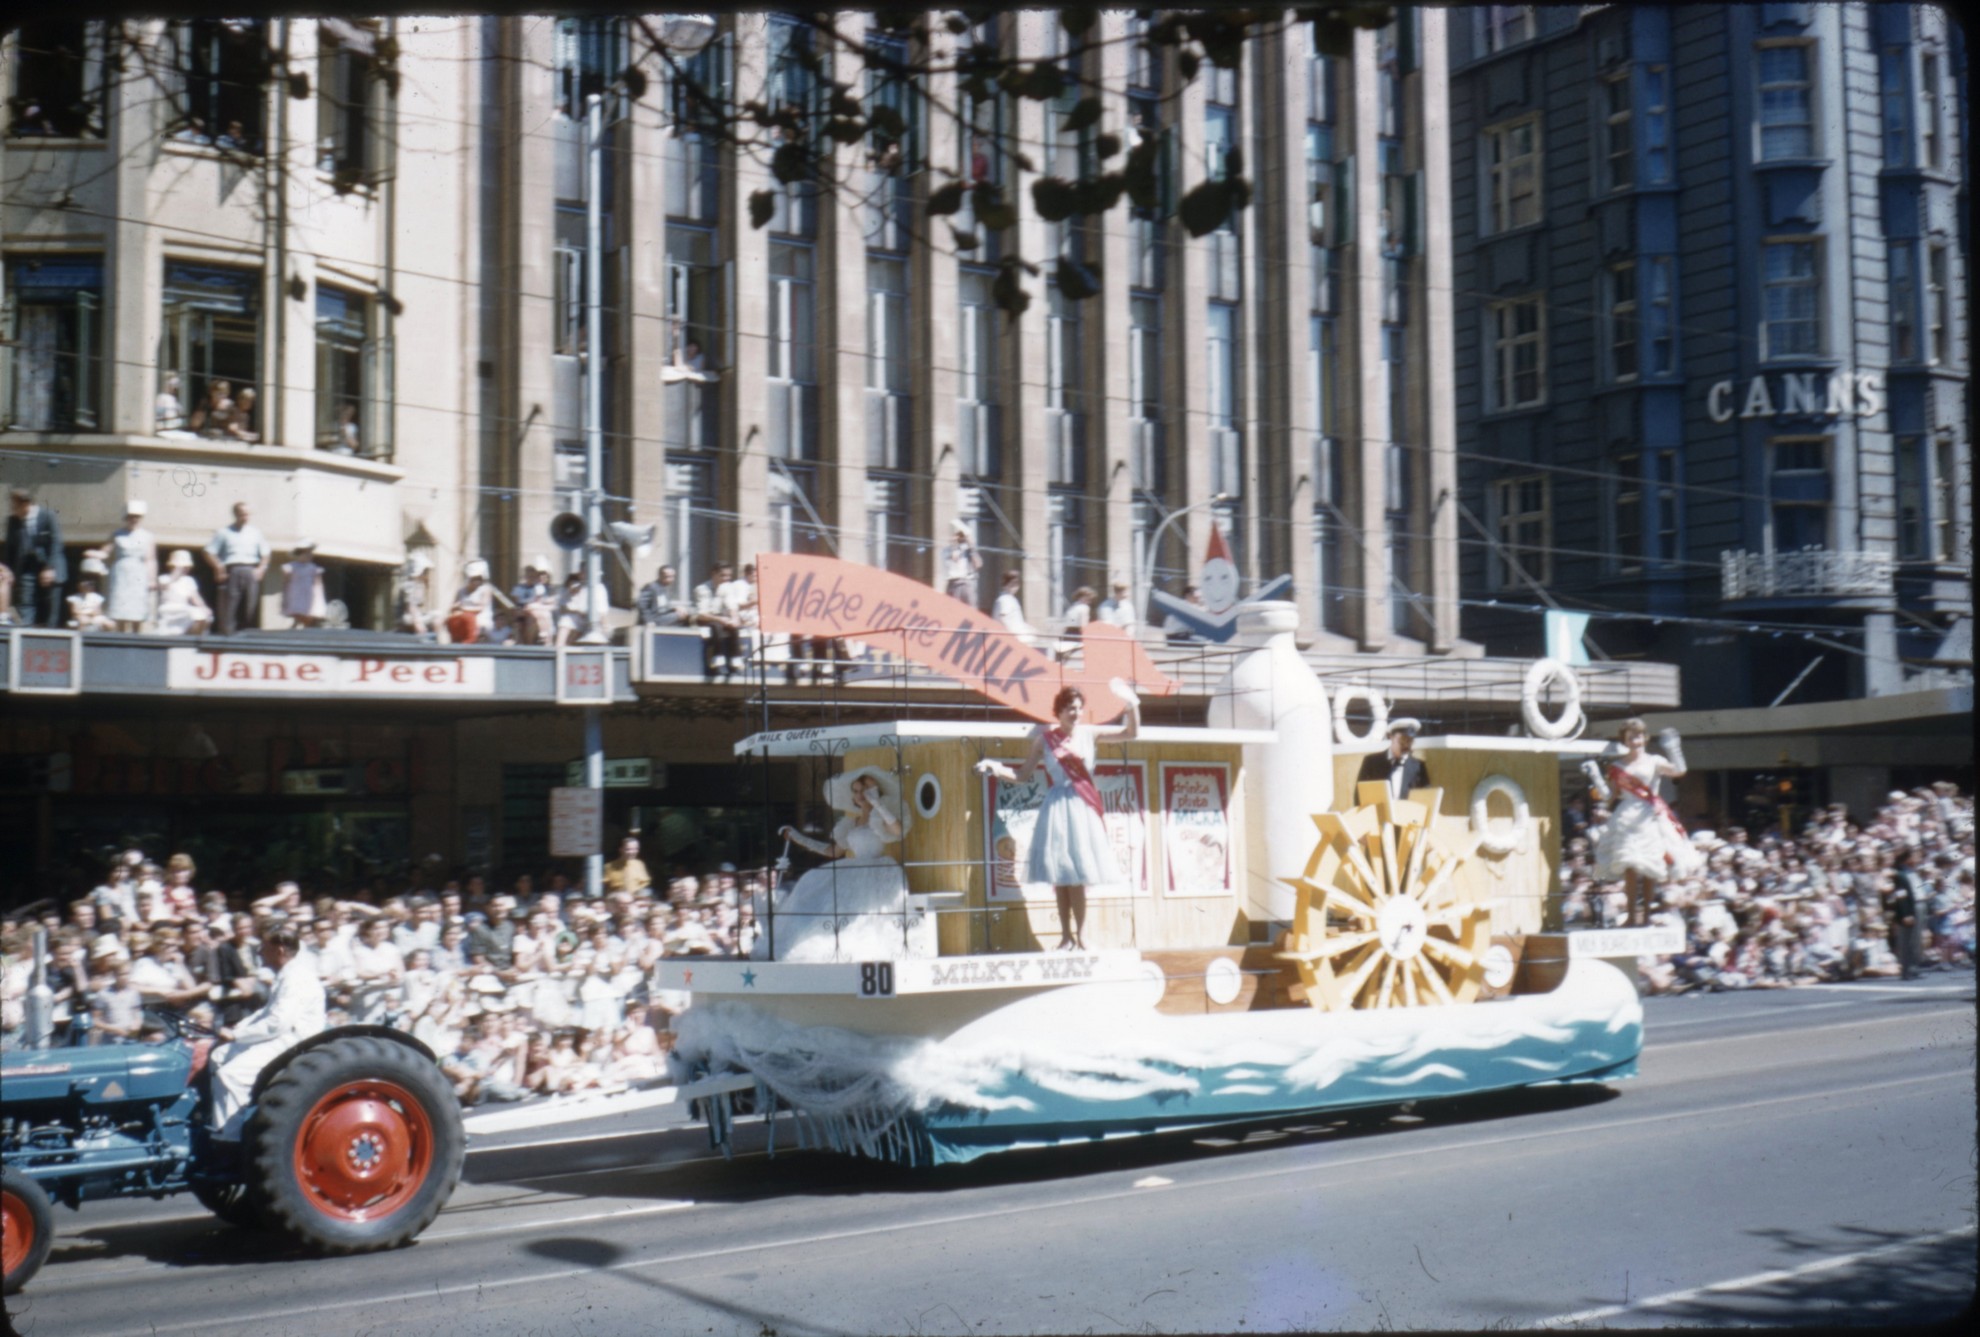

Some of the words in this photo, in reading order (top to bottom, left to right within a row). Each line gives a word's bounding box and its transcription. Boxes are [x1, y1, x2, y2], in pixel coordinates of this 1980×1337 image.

[1708, 372, 1883, 423] CANNS
[776, 571, 863, 631] Make
[866, 599, 942, 648] mine
[939, 617, 1049, 704] MILK
[23, 648, 70, 674] 123
[195, 652, 322, 681] Jane
[353, 656, 467, 684] Peel
[566, 663, 605, 687] 123
[757, 732, 782, 743] MILK
[860, 961, 894, 996] 80
[930, 959, 1030, 987] MILKY
[1035, 955, 1100, 981] WAY
